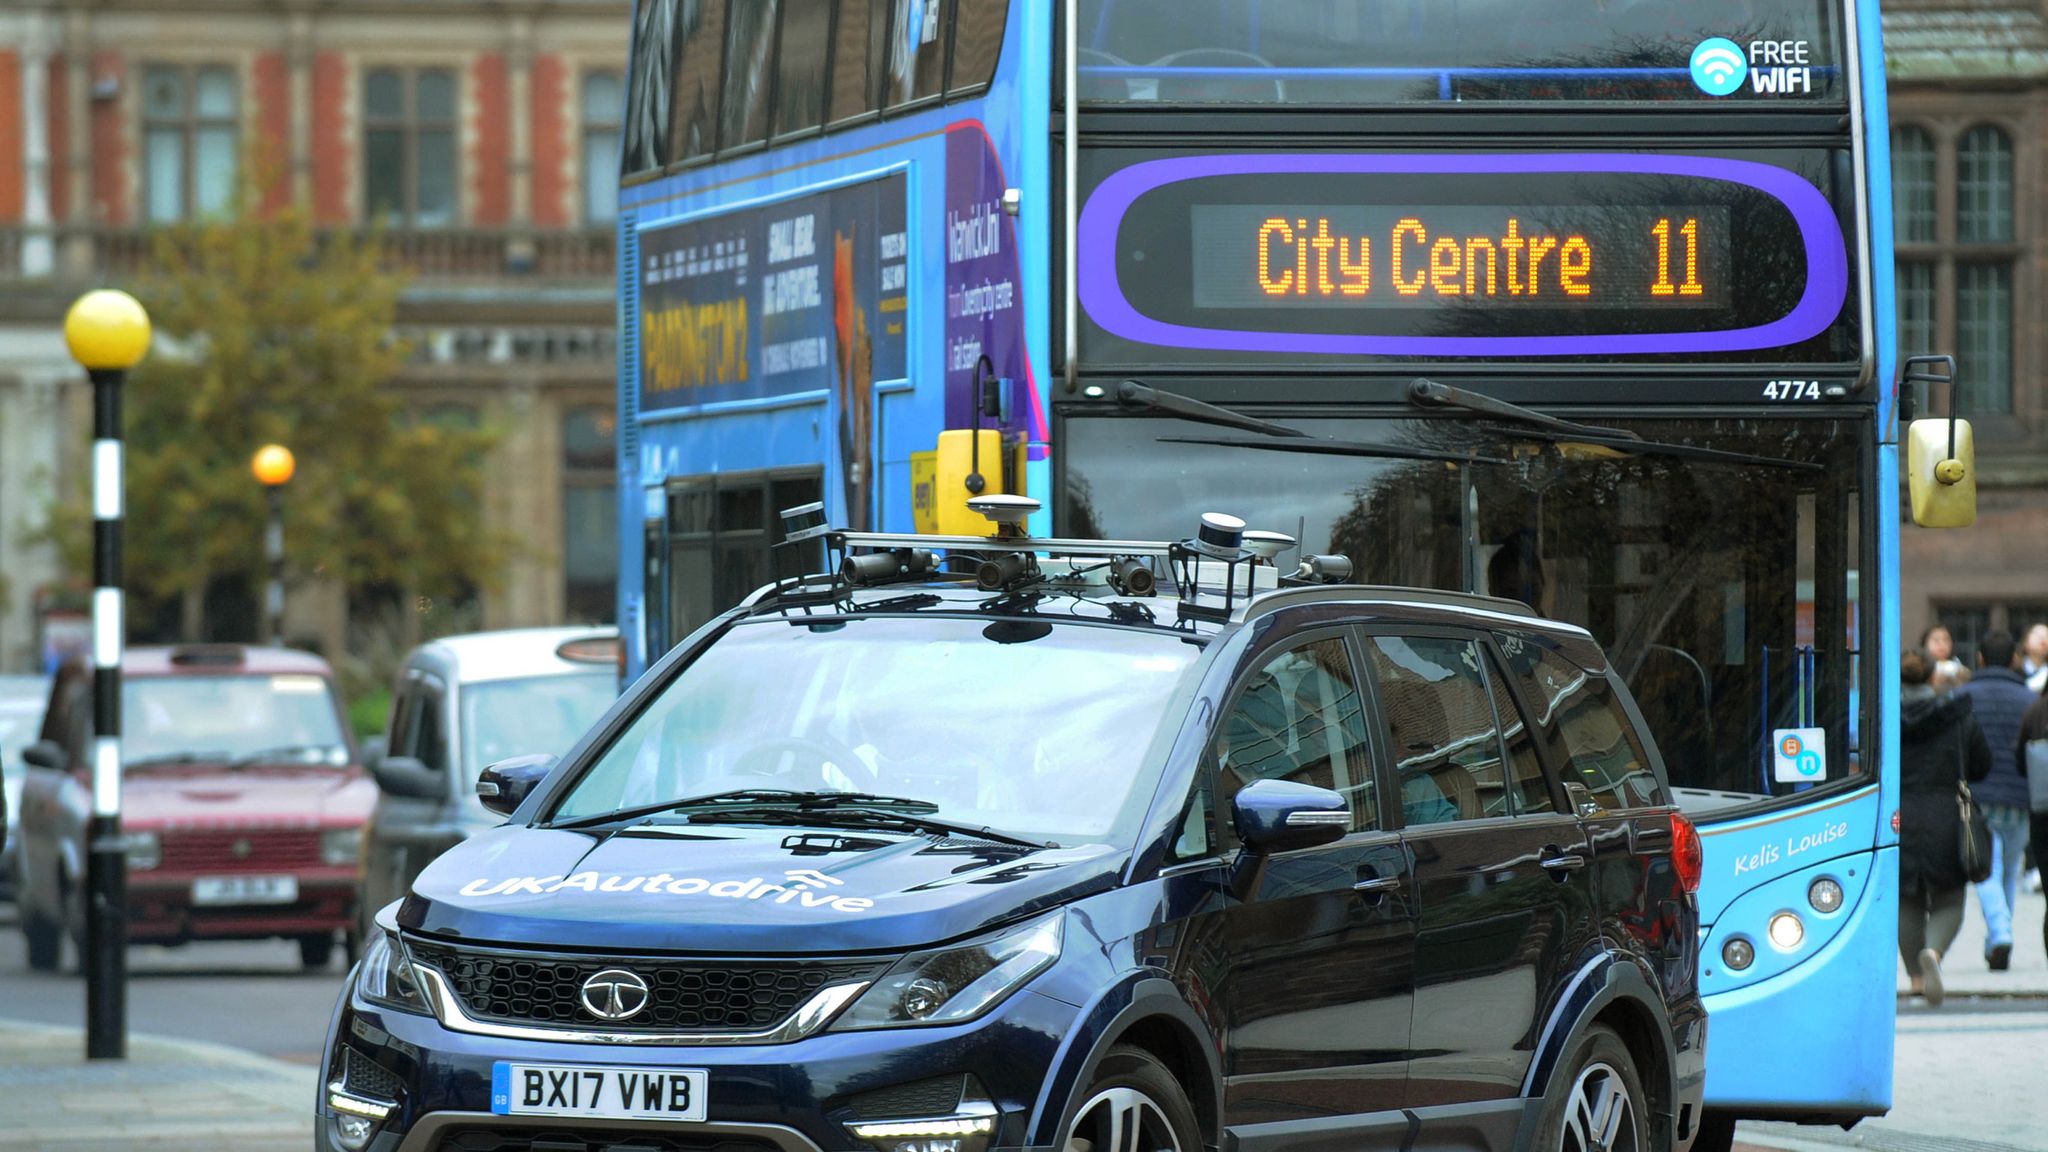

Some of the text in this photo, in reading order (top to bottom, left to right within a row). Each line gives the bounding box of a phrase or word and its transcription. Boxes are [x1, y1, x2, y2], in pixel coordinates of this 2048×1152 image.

[1750, 40, 1809, 65] FREE
[1751, 67, 1811, 93] WIFI
[1259, 218, 1703, 295] City Centre 11
[1763, 381, 1821, 400] 4774
[1734, 822, 1848, 876] Kelis Louise
[523, 1069, 690, 1112] BX17 VWB
